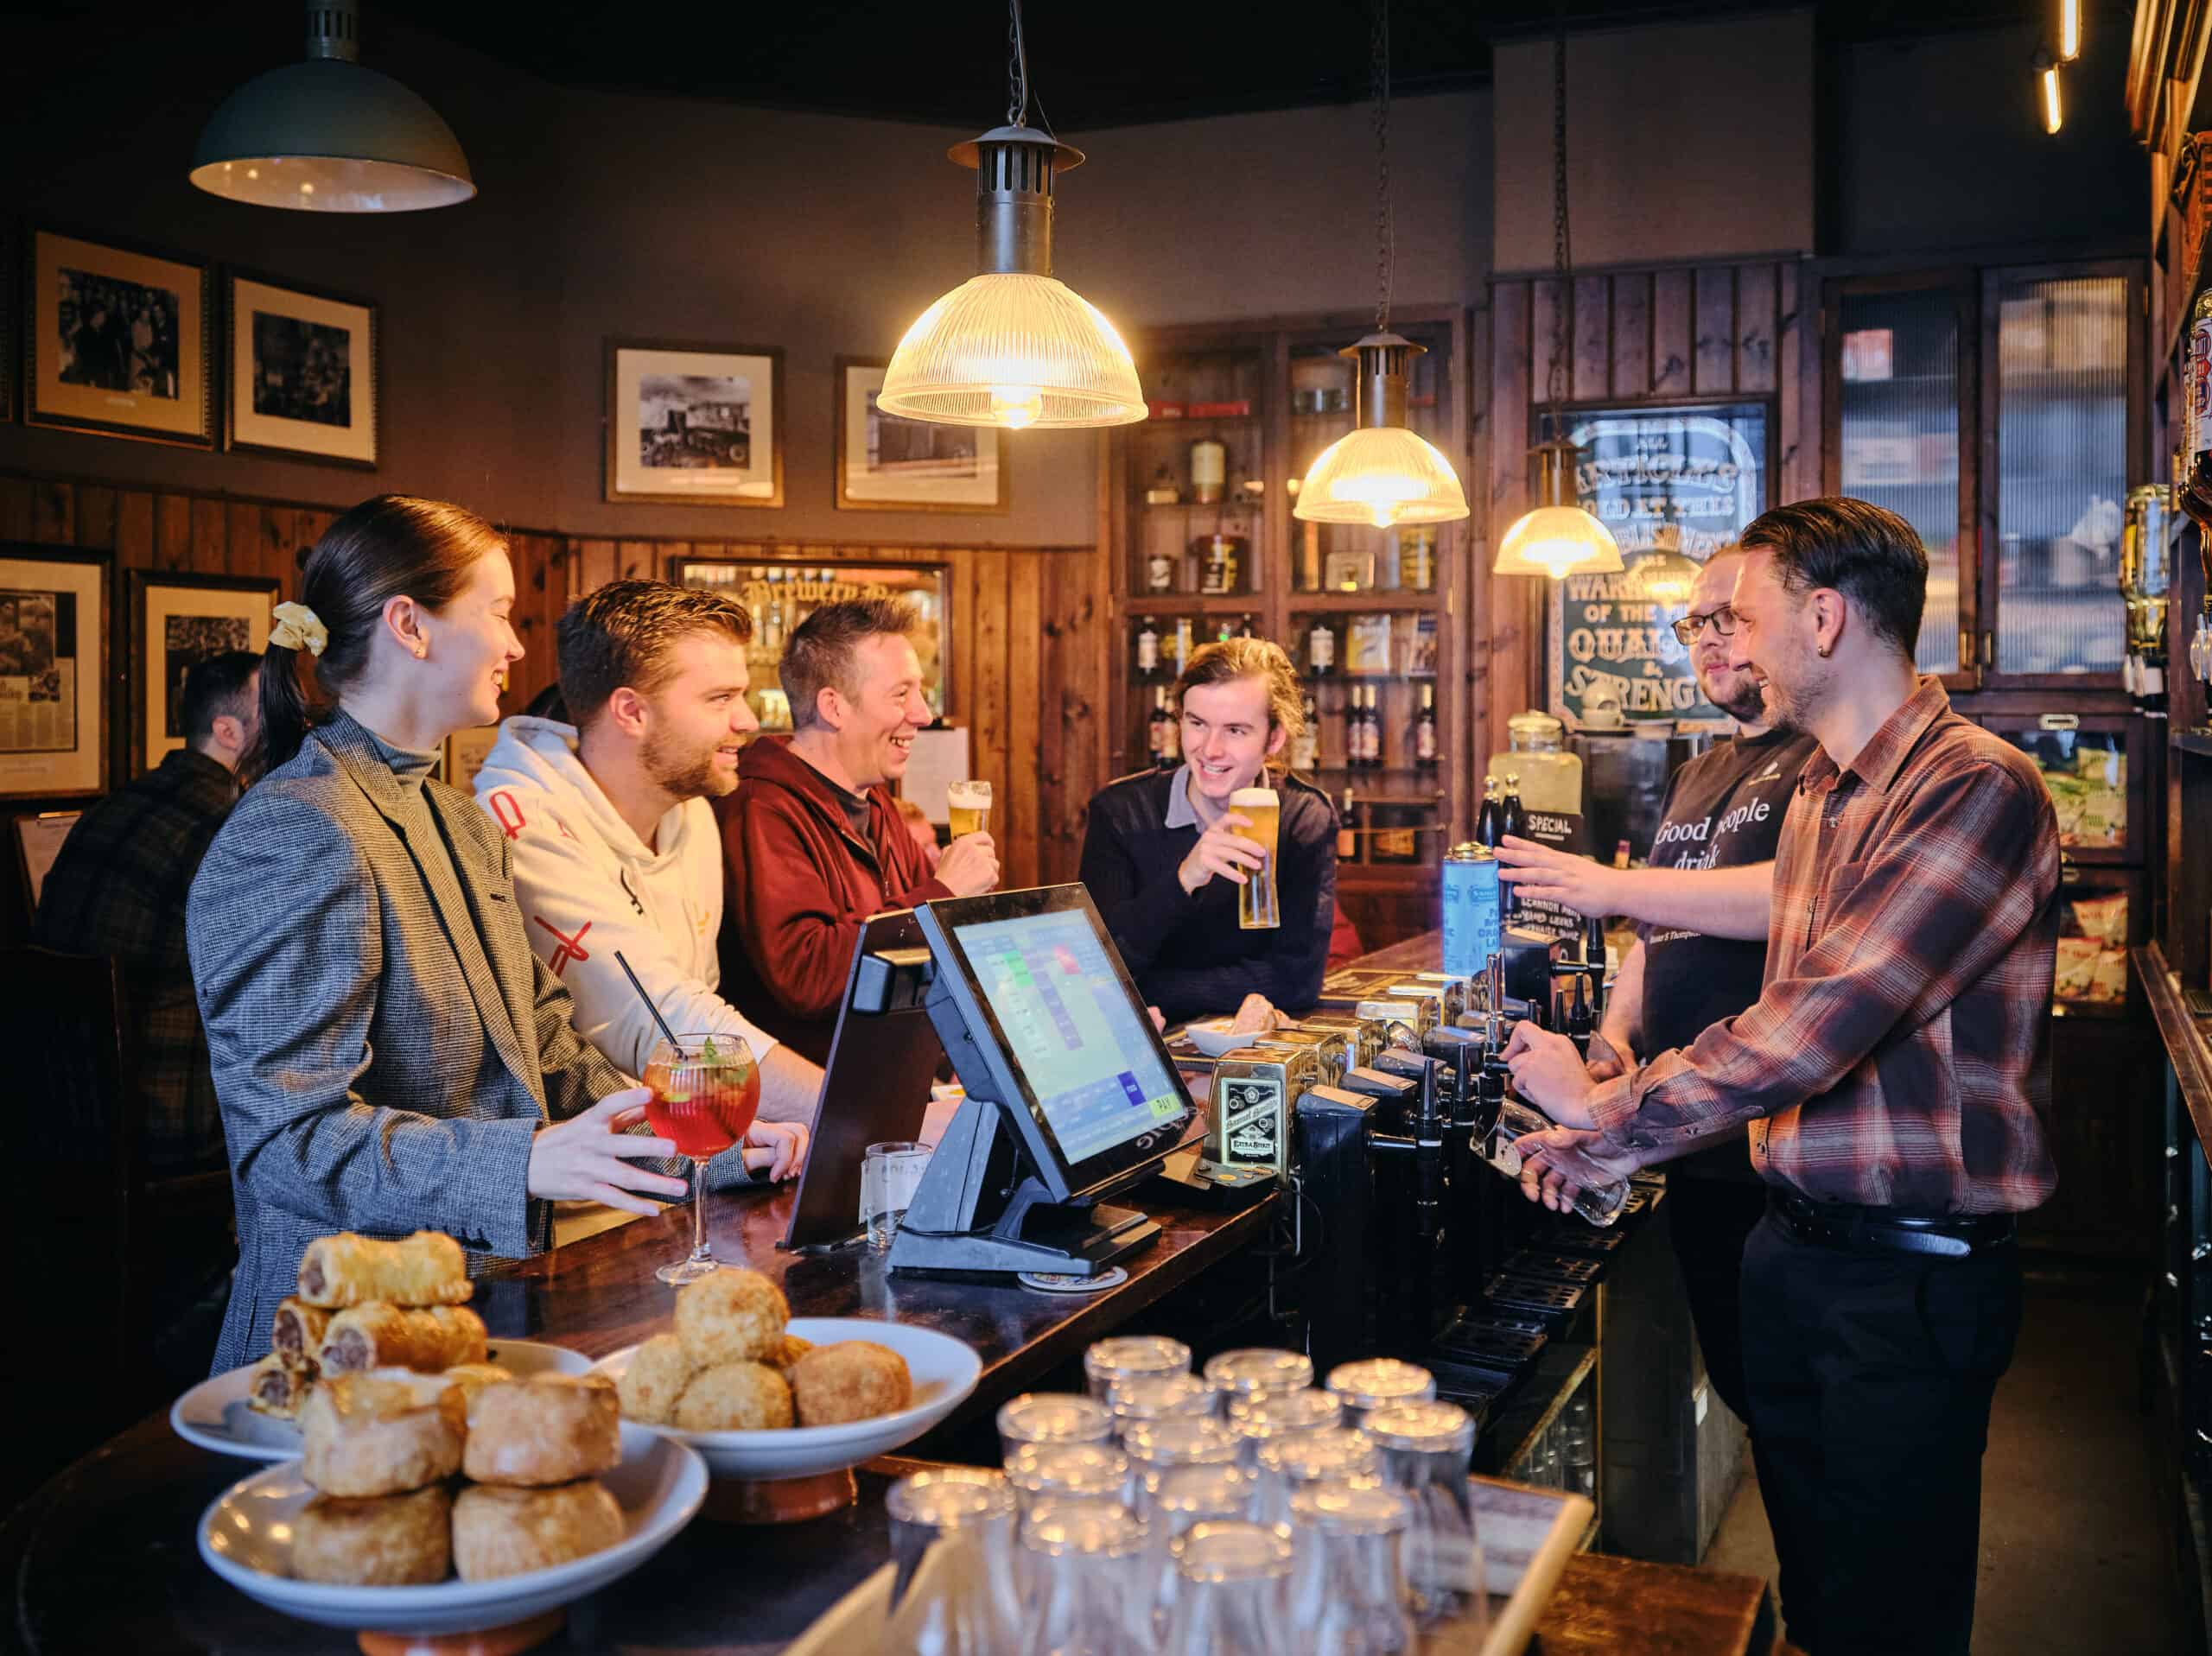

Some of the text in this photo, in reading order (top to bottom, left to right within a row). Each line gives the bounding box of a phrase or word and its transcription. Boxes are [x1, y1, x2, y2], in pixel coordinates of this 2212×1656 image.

[1577, 497, 1630, 519] OLD
[1630, 496, 1668, 518] AT
[1583, 604, 1612, 623] OF
[1619, 604, 1658, 623] THE
[1527, 814, 1573, 834] SPECIAL
[1656, 815, 1712, 845] Good
[1234, 1140, 1253, 1149] EXTRA
